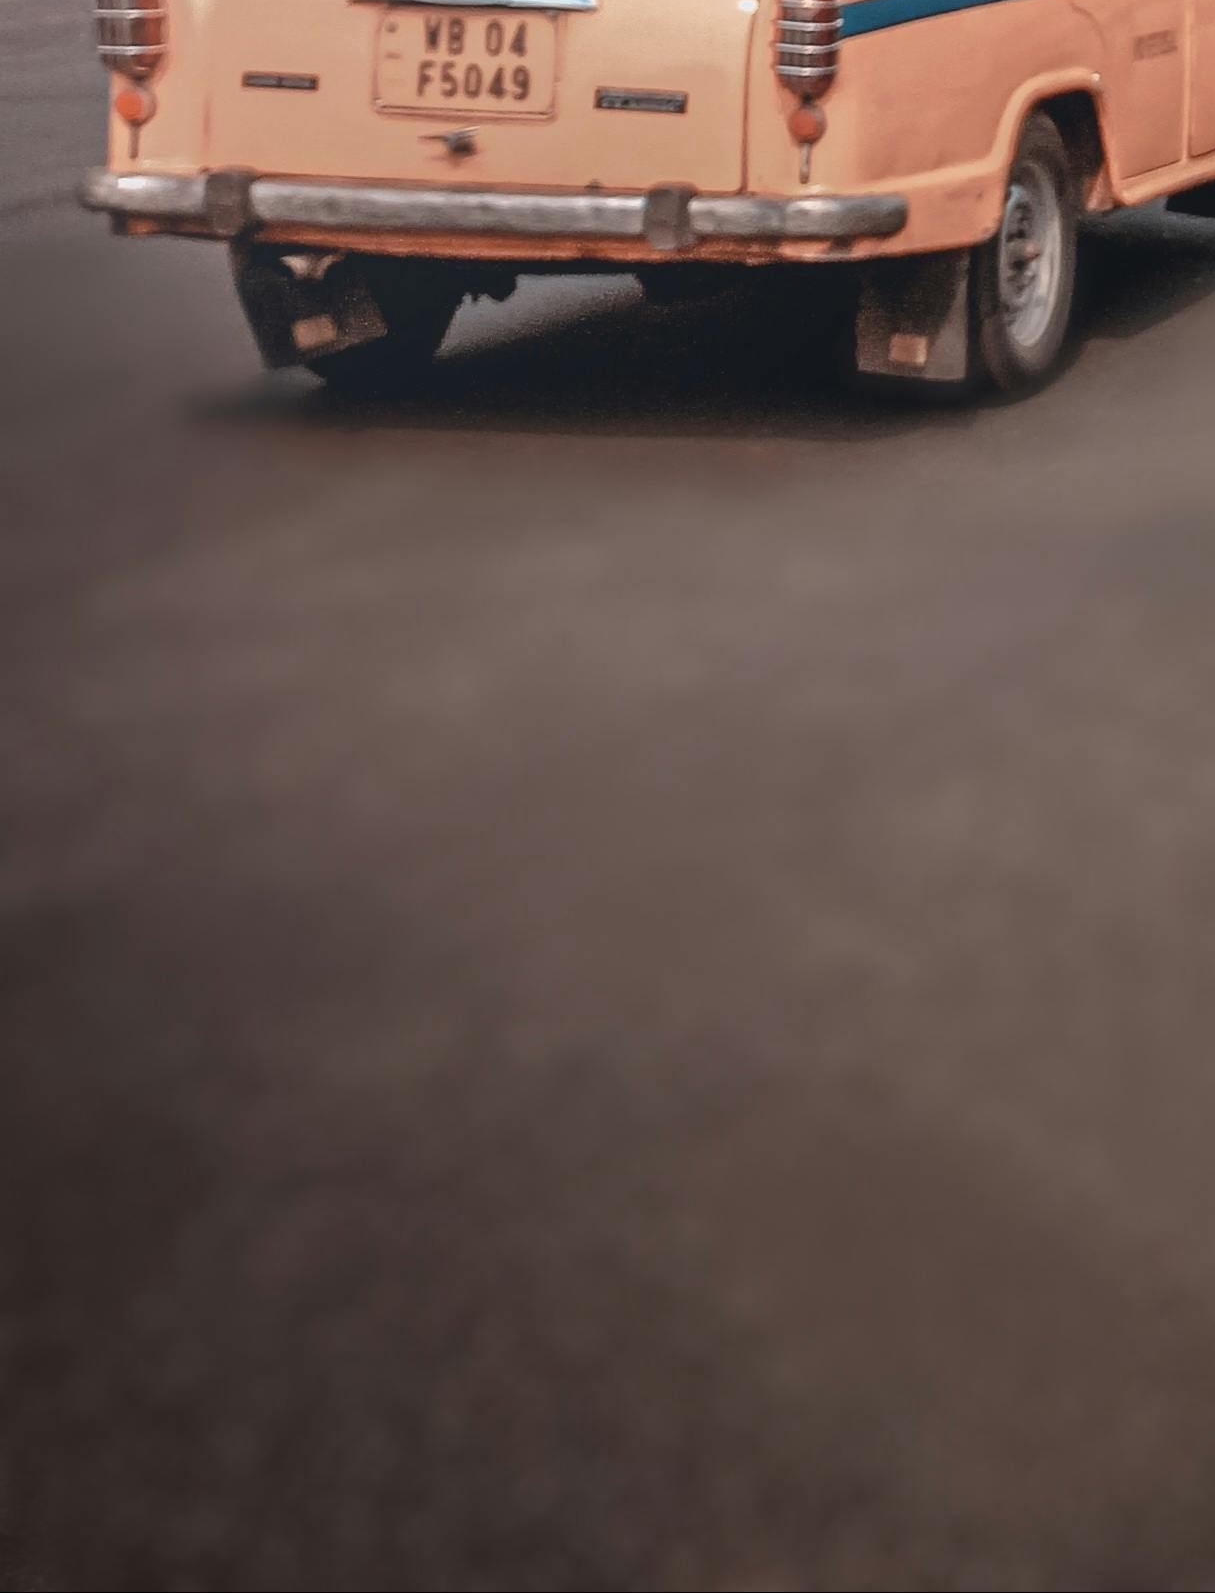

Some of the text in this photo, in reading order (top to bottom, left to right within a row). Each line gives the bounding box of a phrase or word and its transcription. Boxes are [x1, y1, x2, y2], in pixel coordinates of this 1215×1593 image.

[424, 16, 528, 57] WB 04
[416, 60, 531, 101] F5049
